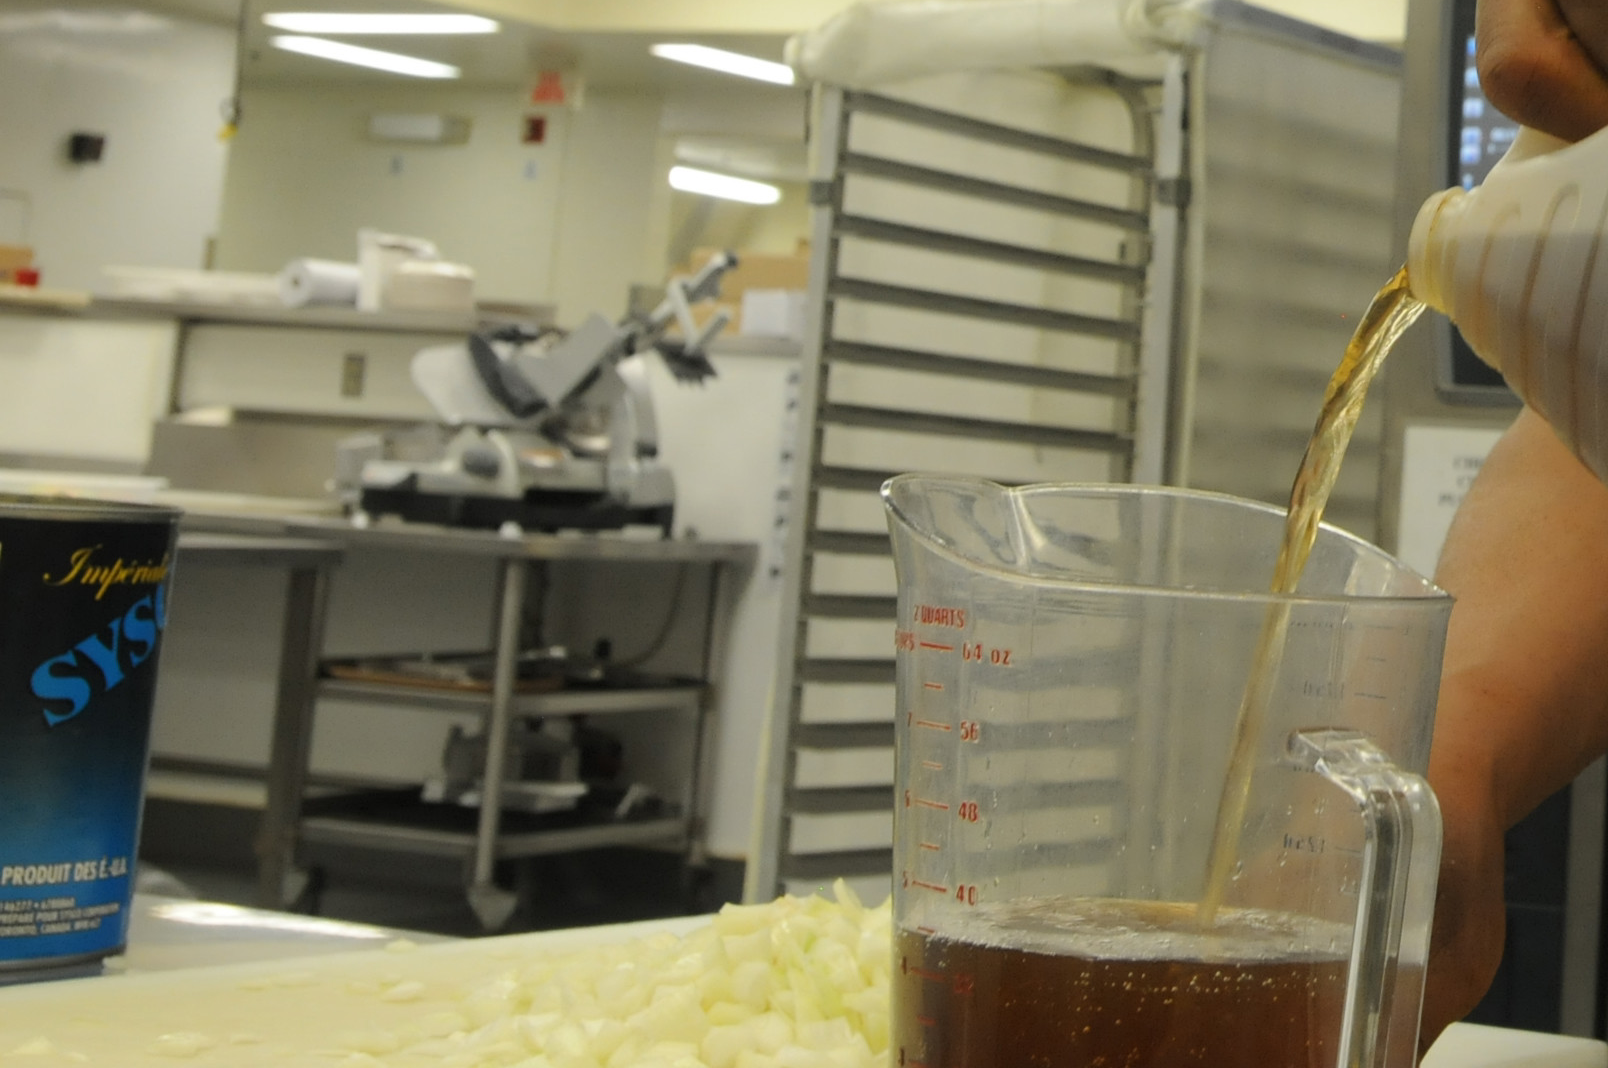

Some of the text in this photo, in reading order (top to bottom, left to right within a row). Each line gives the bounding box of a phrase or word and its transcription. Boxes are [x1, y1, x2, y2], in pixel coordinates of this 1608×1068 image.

[921, 605, 965, 629] QUARTS
[962, 642, 983, 662] 64
[959, 721, 979, 741] 56
[958, 801, 979, 823] 48
[1, 863, 72, 886] PRODUIT
[74, 860, 98, 882] DES
[955, 884, 978, 906] 40
